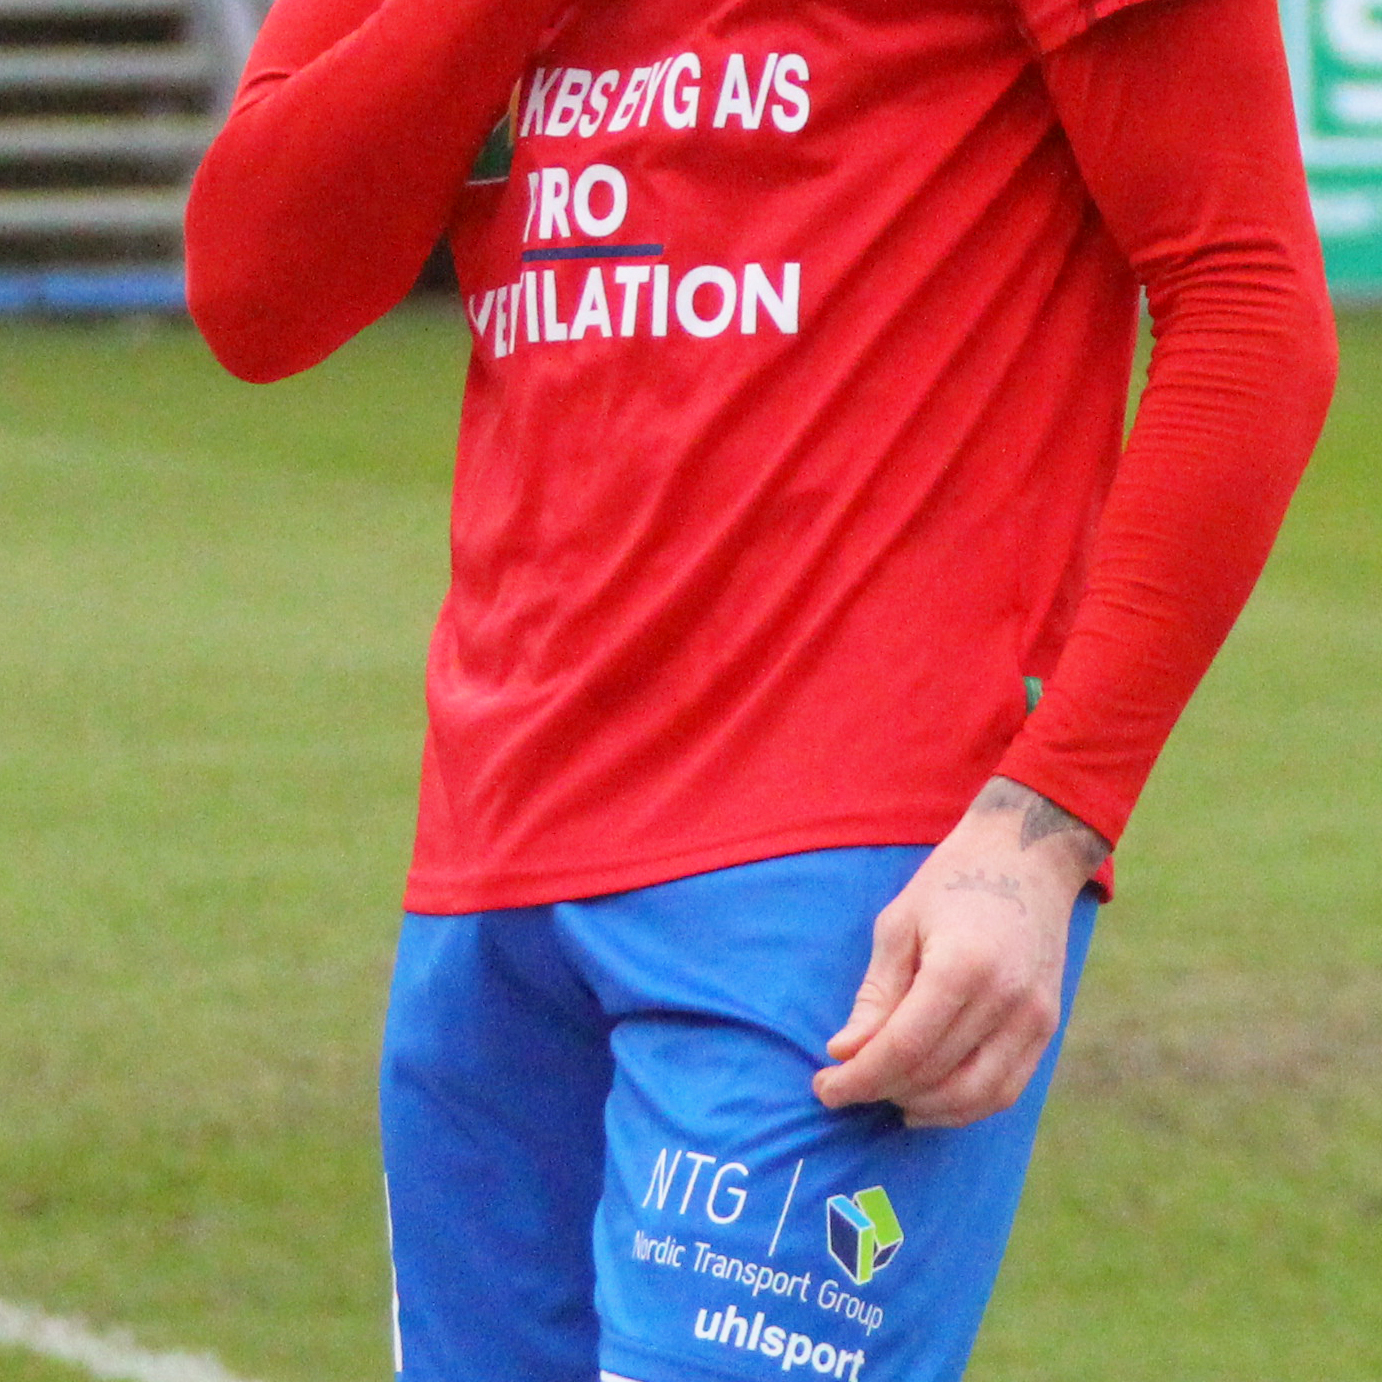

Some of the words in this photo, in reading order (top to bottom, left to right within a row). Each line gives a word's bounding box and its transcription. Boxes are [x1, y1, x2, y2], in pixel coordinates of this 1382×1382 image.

[519, 66, 621, 139] KBS
[607, 51, 702, 133] BYG
[712, 51, 811, 134] A/S
[468, 261, 802, 359] VEILATION
[641, 1147, 750, 1225] NTG
[632, 1229, 686, 1268] Nordic
[693, 1240, 812, 1303] Transport
[818, 1278, 884, 1336] Group
[693, 1304, 866, 1382] uhlsport
